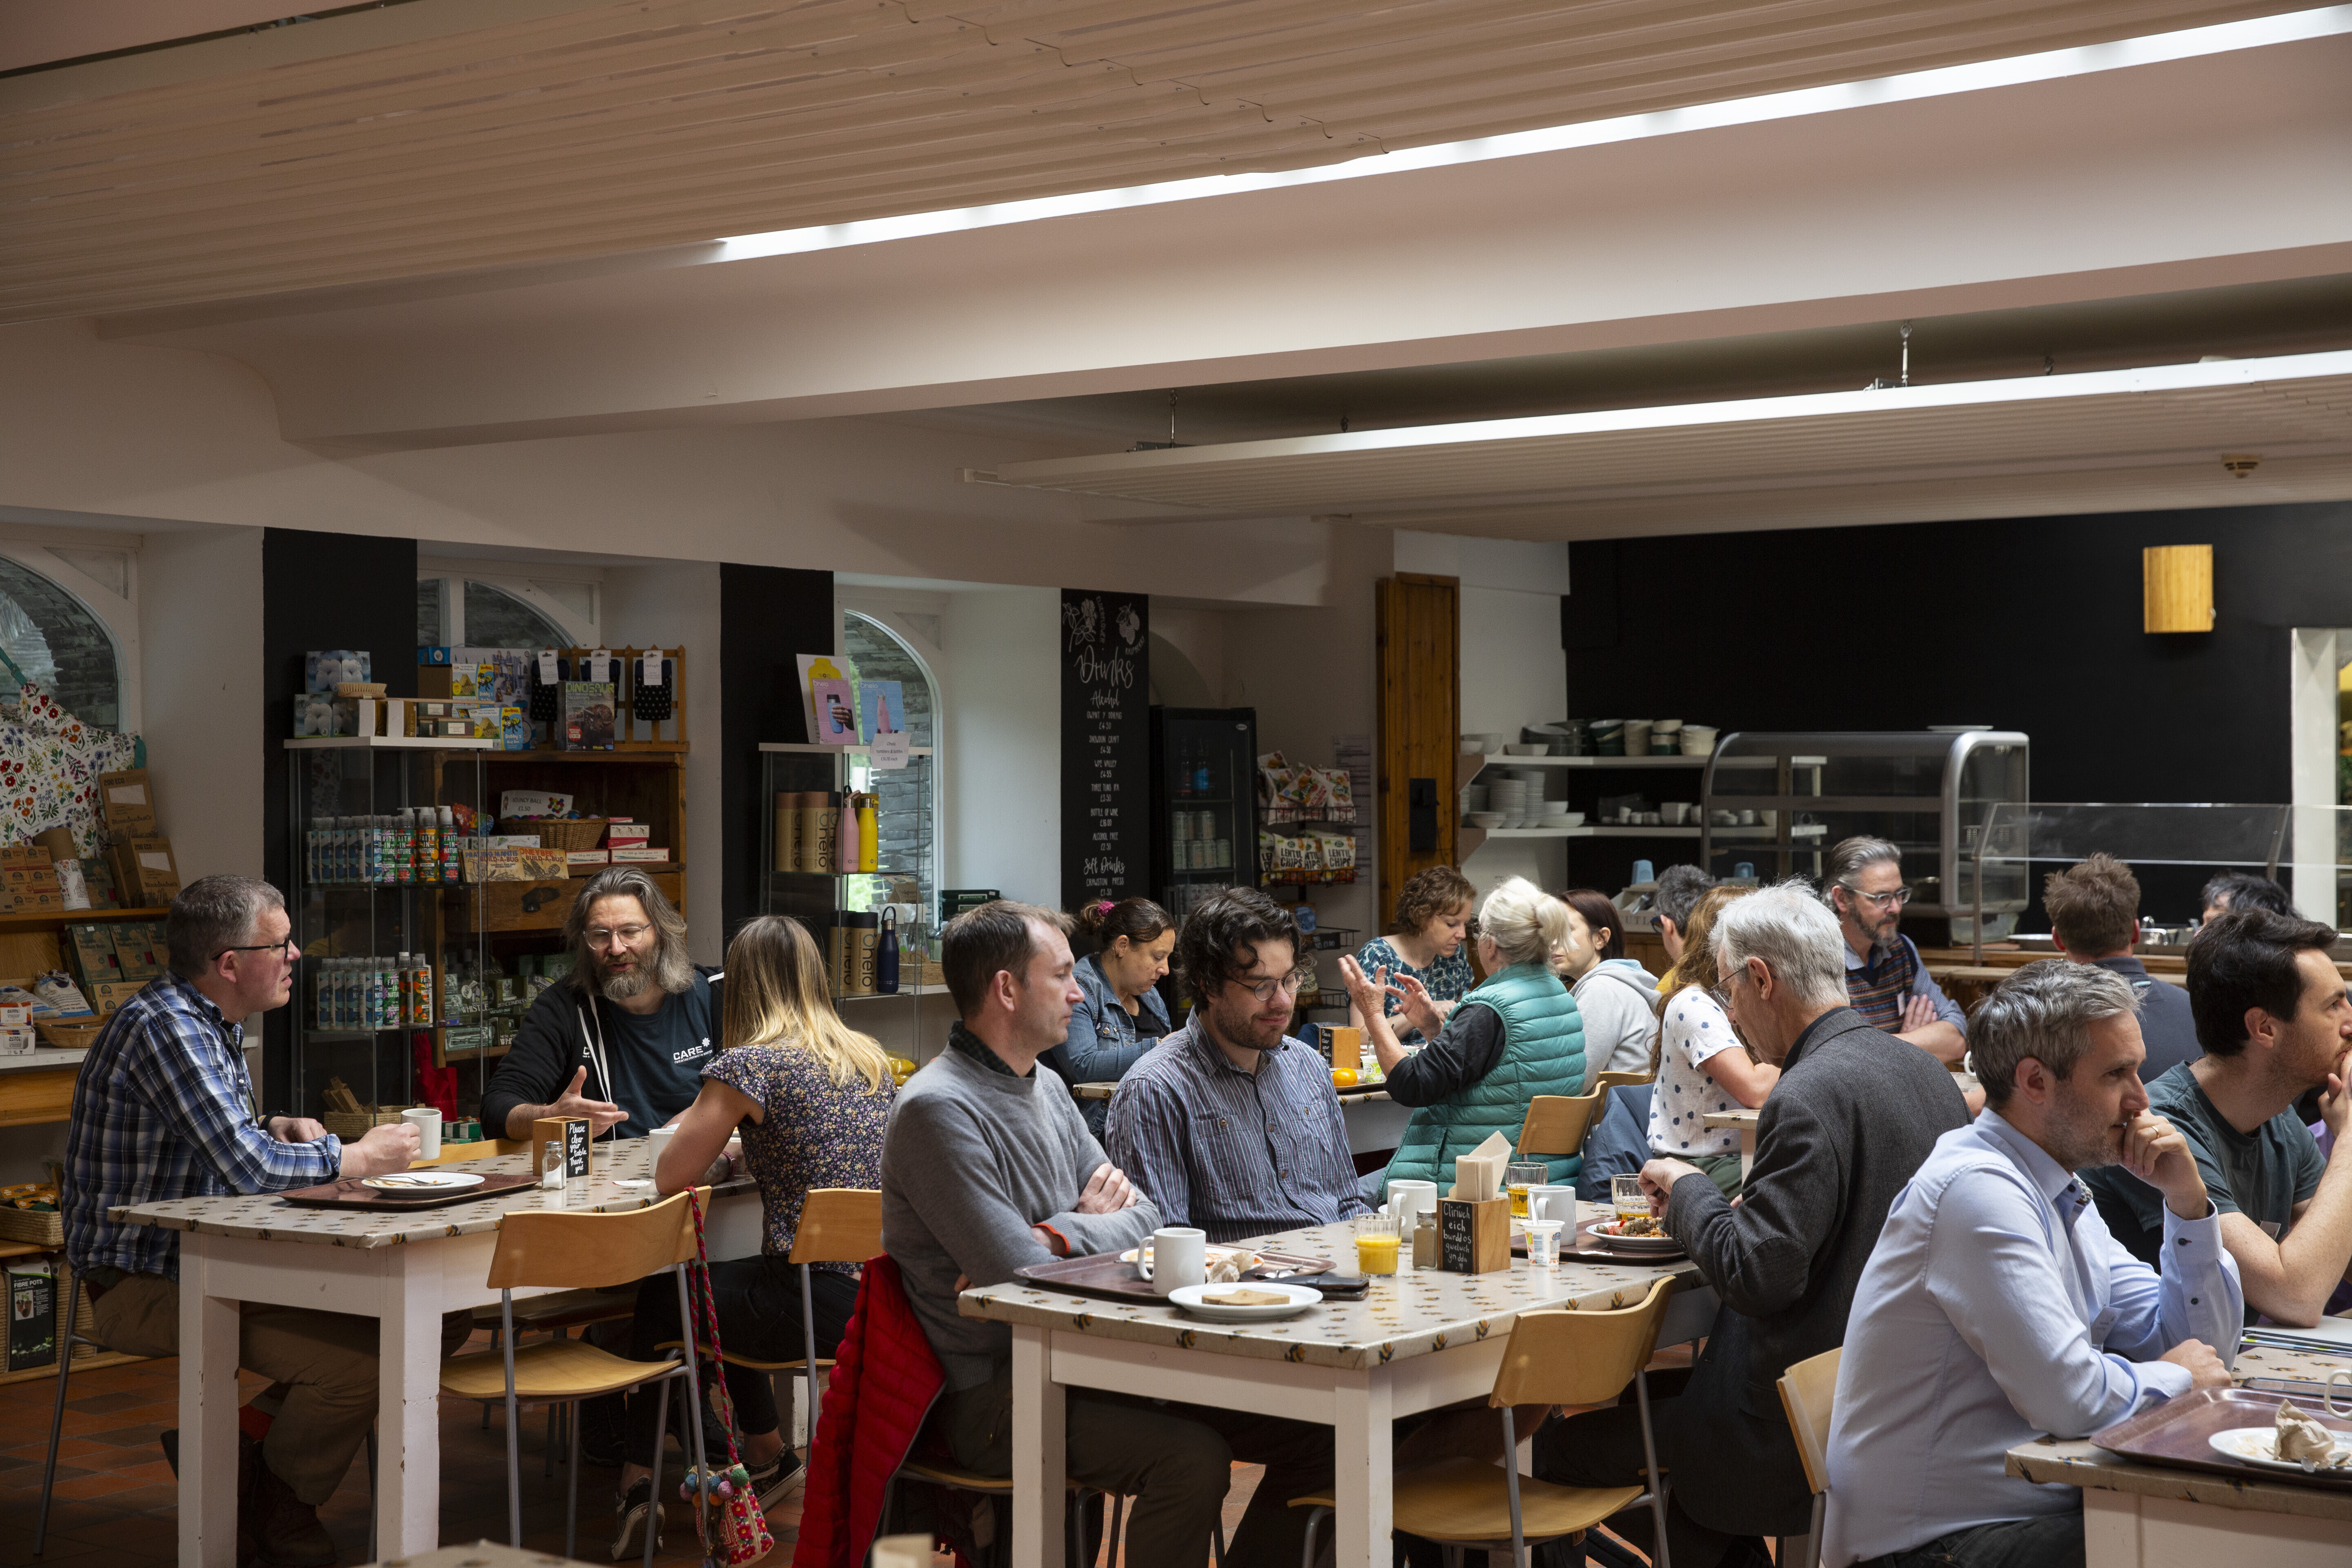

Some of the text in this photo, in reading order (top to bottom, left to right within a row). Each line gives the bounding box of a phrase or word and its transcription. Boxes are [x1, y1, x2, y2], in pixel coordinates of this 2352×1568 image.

[1074, 645, 1134, 688] Drinks
[566, 683, 614, 693] DINOSAUR
[1090, 689, 1120, 708] Alcohol
[520, 849, 553, 858] ONEYBEE
[1281, 848, 1303, 858] LENTIL
[1305, 852, 1320, 860] NTIL
[1328, 849, 1351, 858] LENTIL
[1083, 856, 1125, 875] Soft Drinks
[1281, 858, 1303, 869] CHIPS
[1305, 861, 1322, 869] HIPS
[1330, 858, 1351, 868] CHIPS
[1112, 877, 1124, 886] PRESS
[673, 1045, 704, 1061] CARE
[569, 1123, 586, 1135] Please
[571, 1134, 583, 1144] clear
[570, 1144, 581, 1153] your
[574, 1147, 587, 1157] table
[569, 1156, 584, 1166] Thank
[1449, 1219, 1466, 1232] eich
[1443, 1229, 1472, 1244] bwrdd os
[1445, 1243, 1470, 1253] gwelwch
[1448, 1252, 1468, 1263] yn dda
